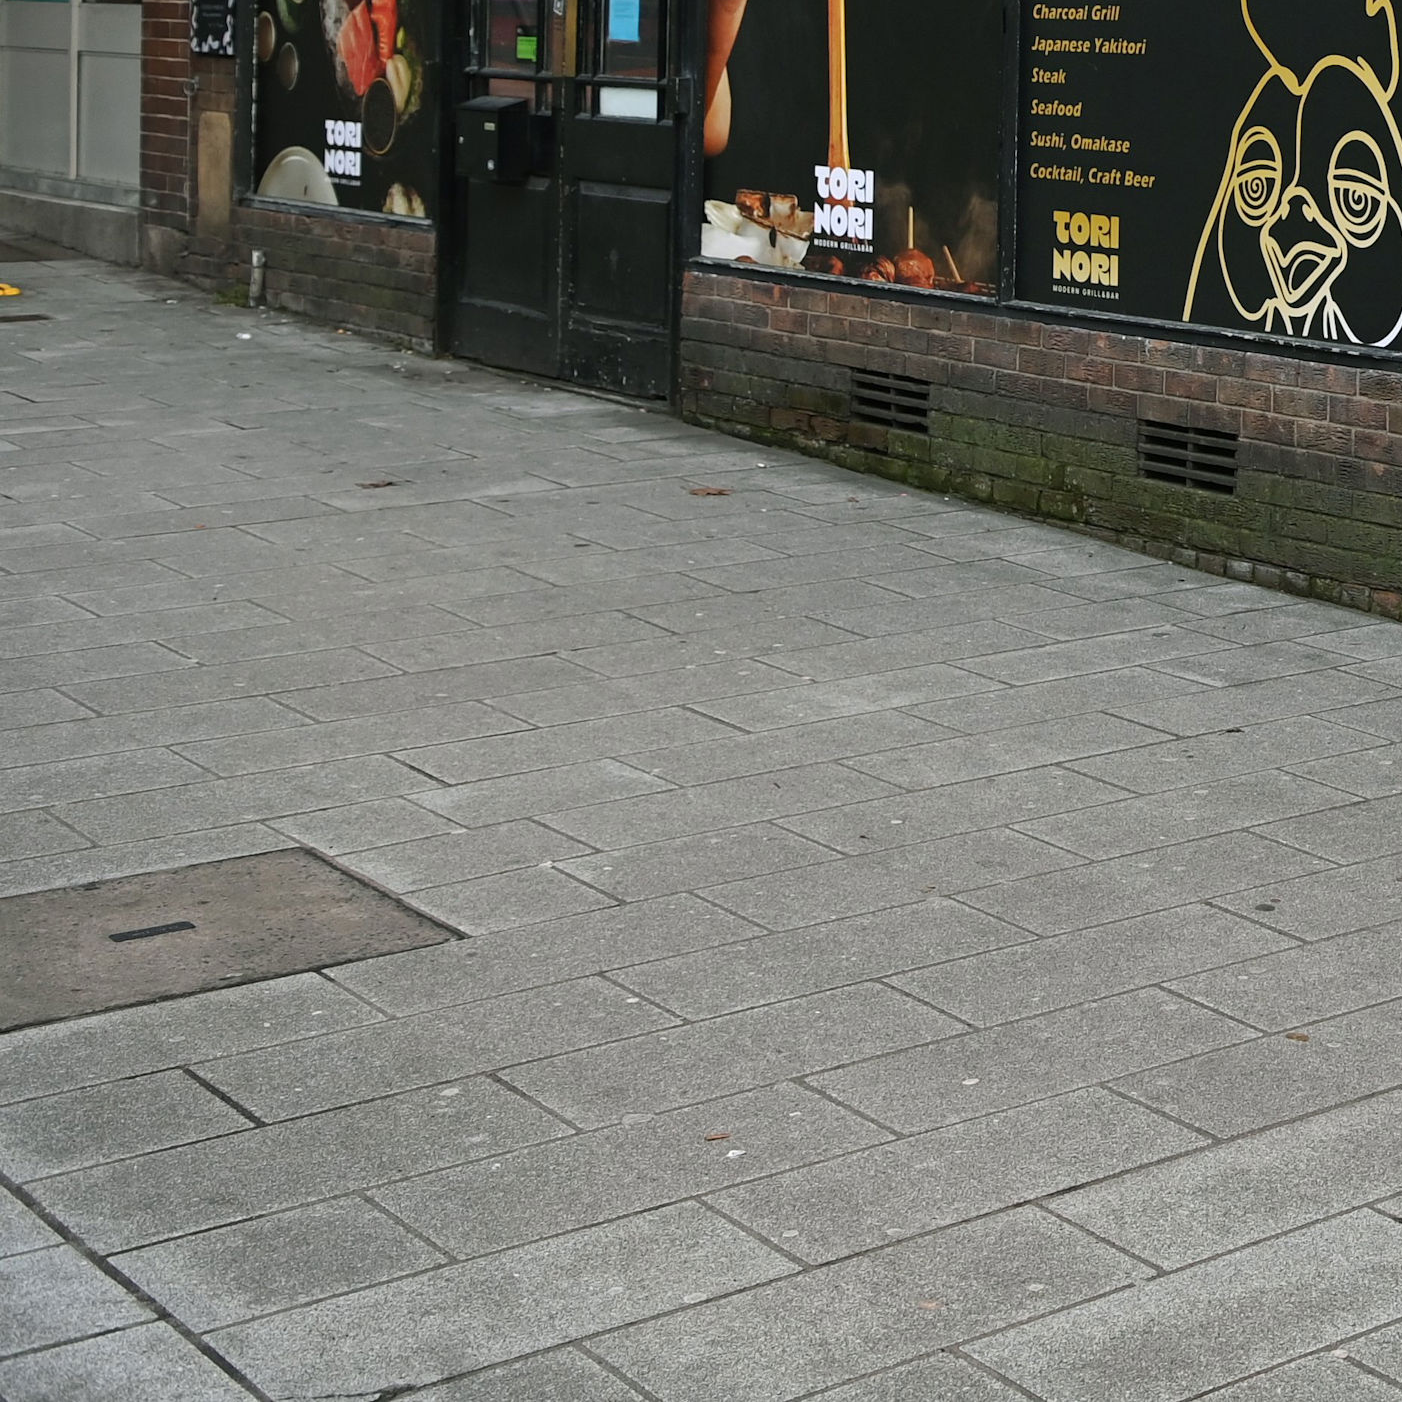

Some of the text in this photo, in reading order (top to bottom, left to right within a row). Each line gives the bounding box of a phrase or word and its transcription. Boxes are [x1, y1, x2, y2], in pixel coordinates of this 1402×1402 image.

[1032, 4, 1120, 21] Charcoal Grill
[1031, 36, 1147, 55] Japanese Yakitori
[1031, 68, 1066, 84] Steak
[1031, 99, 1082, 117] Seafood
[325, 119, 362, 148] TORI
[1030, 131, 1131, 153] Sushi, Omakase
[324, 148, 361, 177] NORI
[1030, 163, 1155, 188] Cocktail, Craft Beer
[814, 165, 874, 204] TORI
[814, 201, 873, 241] NORI
[1053, 210, 1120, 249] TORI
[1053, 248, 1119, 287] NORI
